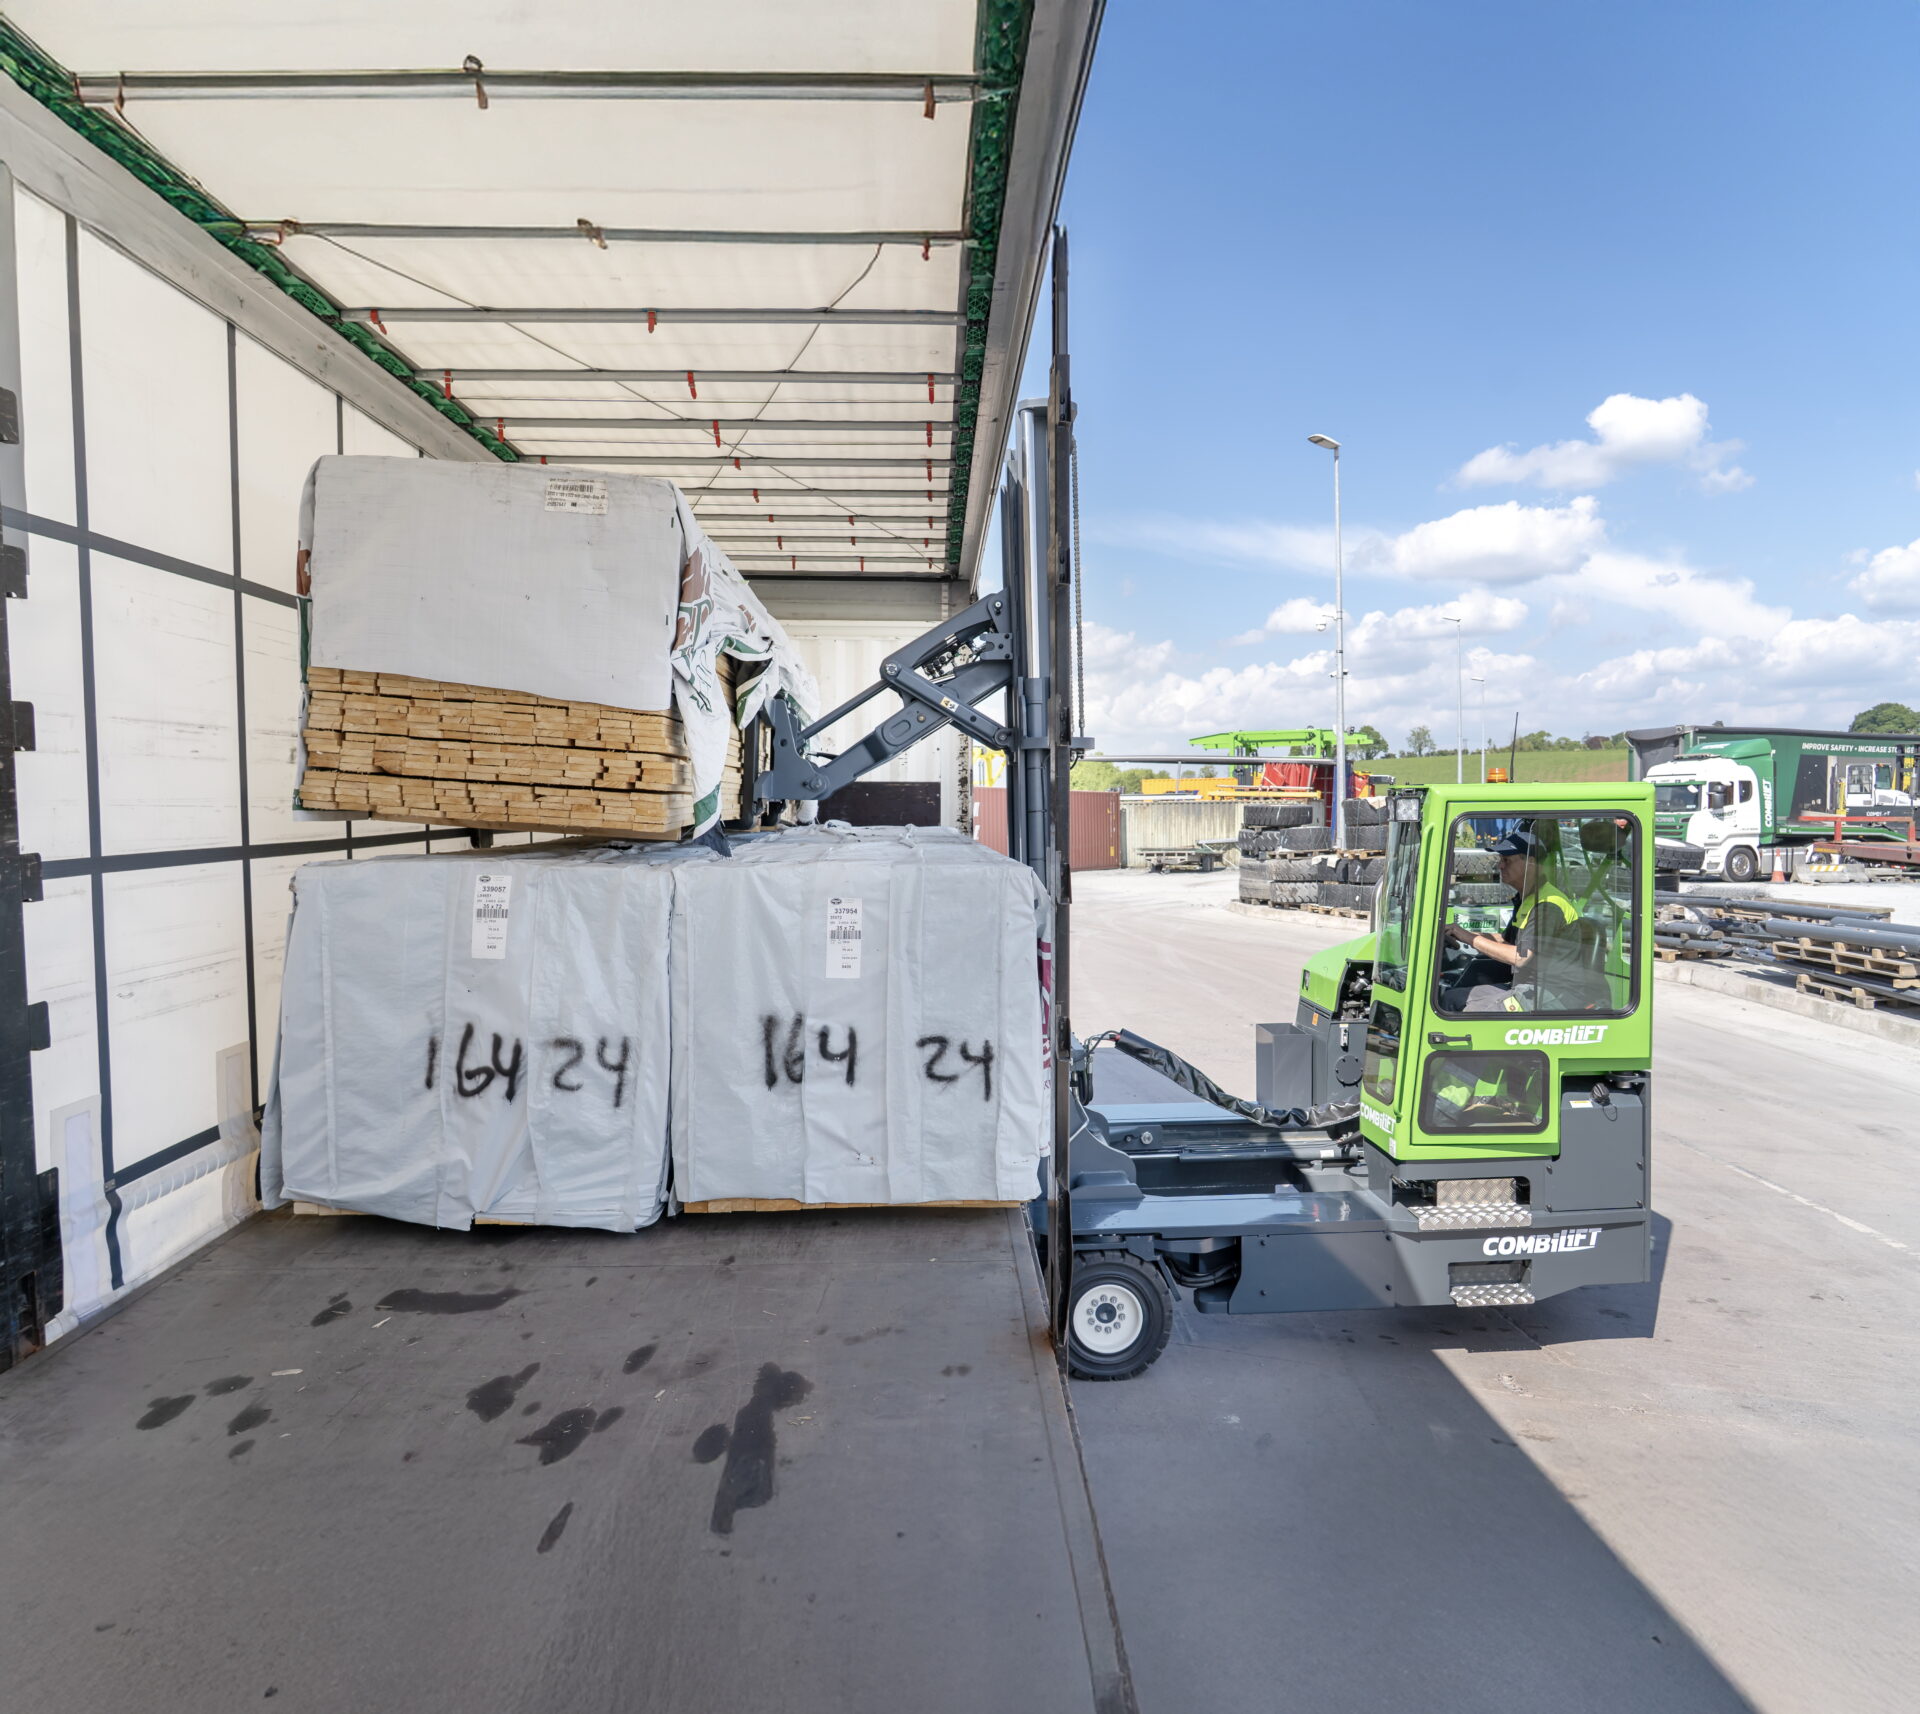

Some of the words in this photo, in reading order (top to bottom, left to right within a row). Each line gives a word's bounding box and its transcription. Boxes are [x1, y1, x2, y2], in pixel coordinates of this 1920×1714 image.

[1801, 742, 1830, 751] IMPROVE
[1830, 744, 1854, 752] SAFETY
[1858, 745, 1888, 753] INCREASE
[424, 1022, 522, 1105] 164
[550, 1036, 630, 1108] 24
[762, 1013, 857, 1092] 164
[916, 1035, 994, 1102] 24
